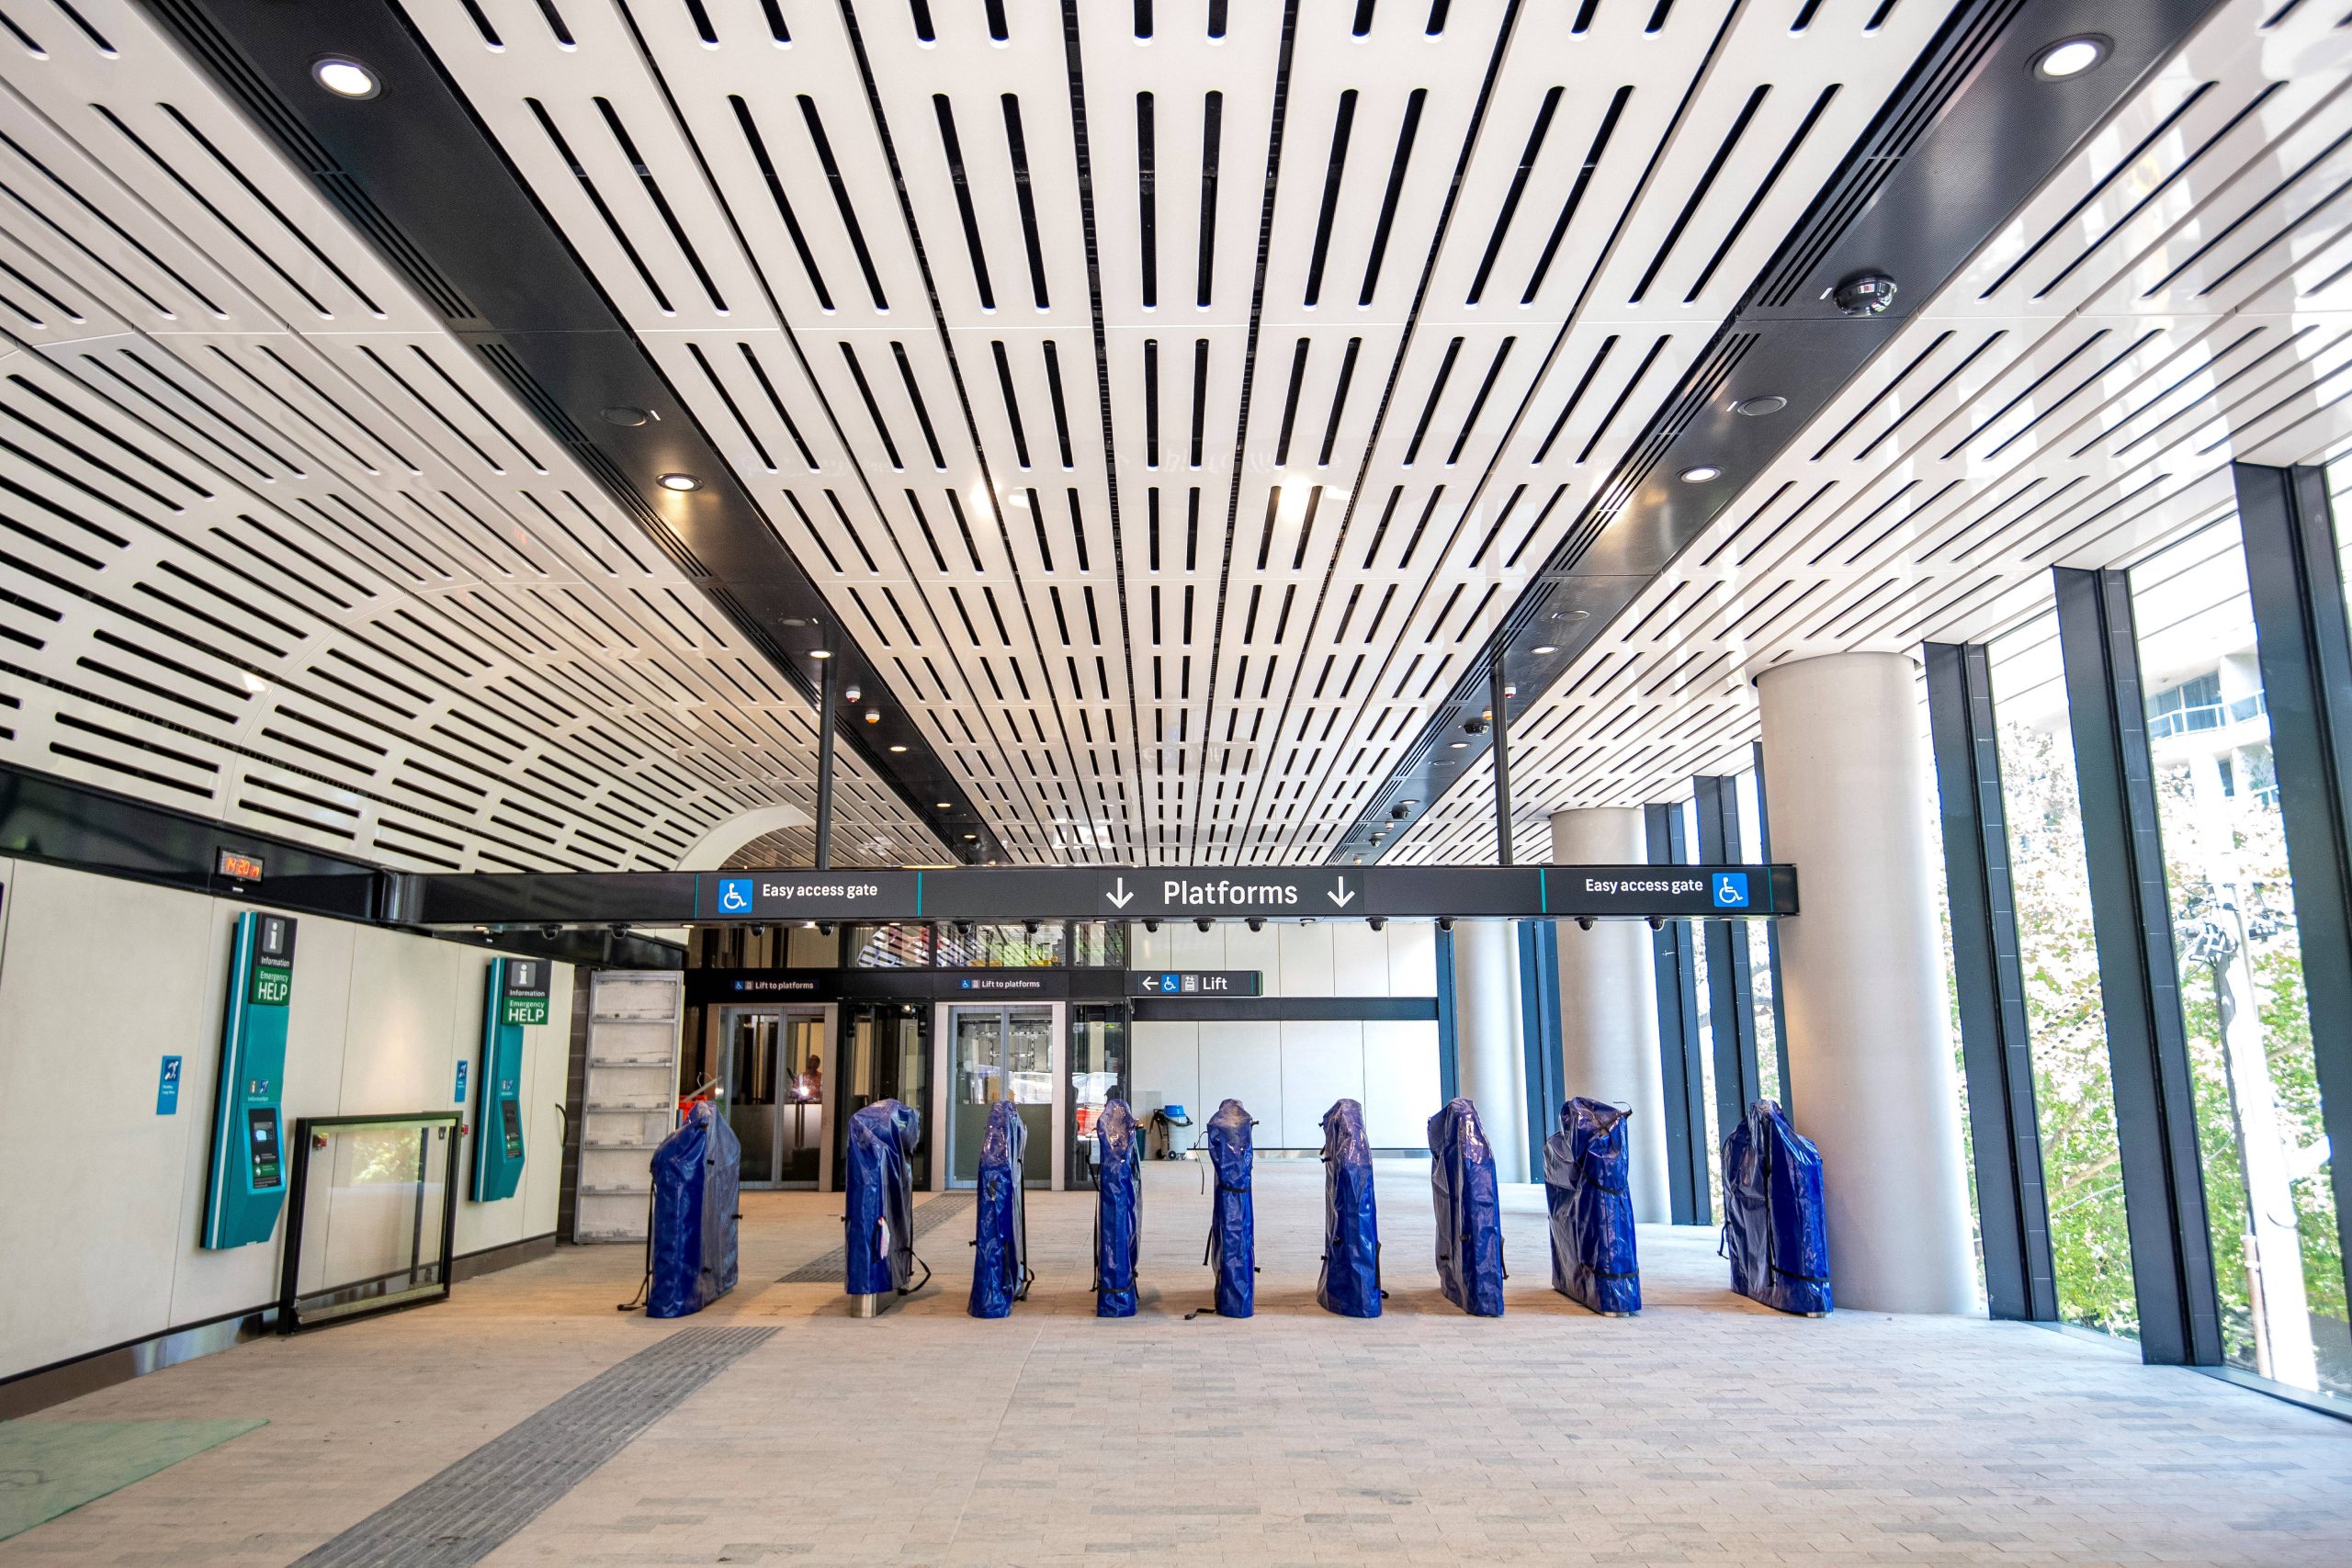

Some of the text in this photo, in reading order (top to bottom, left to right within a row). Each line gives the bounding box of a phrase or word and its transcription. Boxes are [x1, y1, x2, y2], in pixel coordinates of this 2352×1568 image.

[763, 884, 878, 899] Easy access gate
[1163, 880, 1298, 905] Platforms
[1585, 878, 1703, 895] Easy access gate
[261, 956, 290, 967] Information
[260, 971, 288, 983] Emergency
[1203, 976, 1227, 990] Lift
[258, 981, 288, 1001] HELP
[755, 981, 768, 989] Lift
[778, 981, 814, 991] platforms
[1004, 980, 1041, 989] platforms
[510, 999, 545, 1009] Emergency
[508, 1008, 545, 1022] HELP
